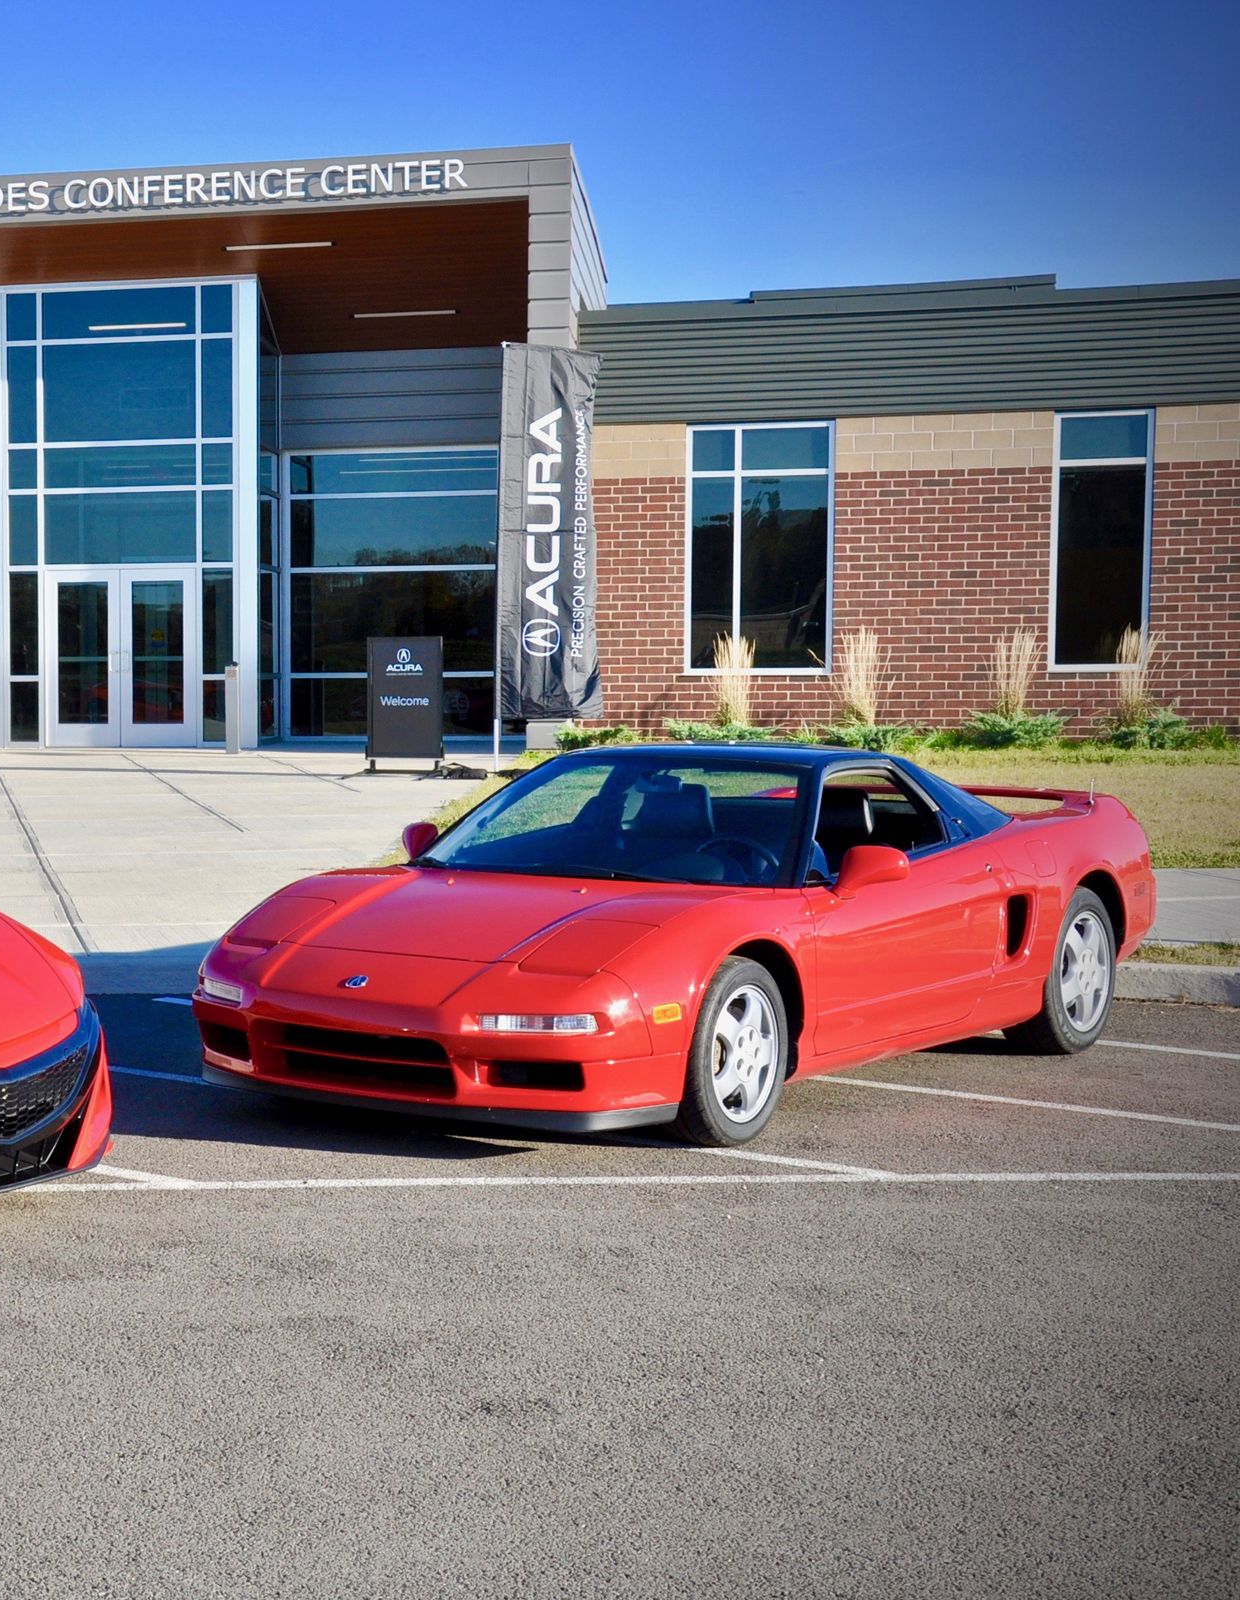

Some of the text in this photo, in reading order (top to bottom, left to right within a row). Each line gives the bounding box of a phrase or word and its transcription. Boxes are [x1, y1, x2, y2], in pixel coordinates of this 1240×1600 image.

[63, 167, 306, 209] CONFERENCE
[320, 158, 469, 195] CENTER
[525, 407, 562, 617] ACURA
[573, 516, 587, 579] CRAFTED
[571, 585, 585, 658] PRECISION
[386, 664, 422, 672] ACURA
[380, 696, 429, 706] Welcome
